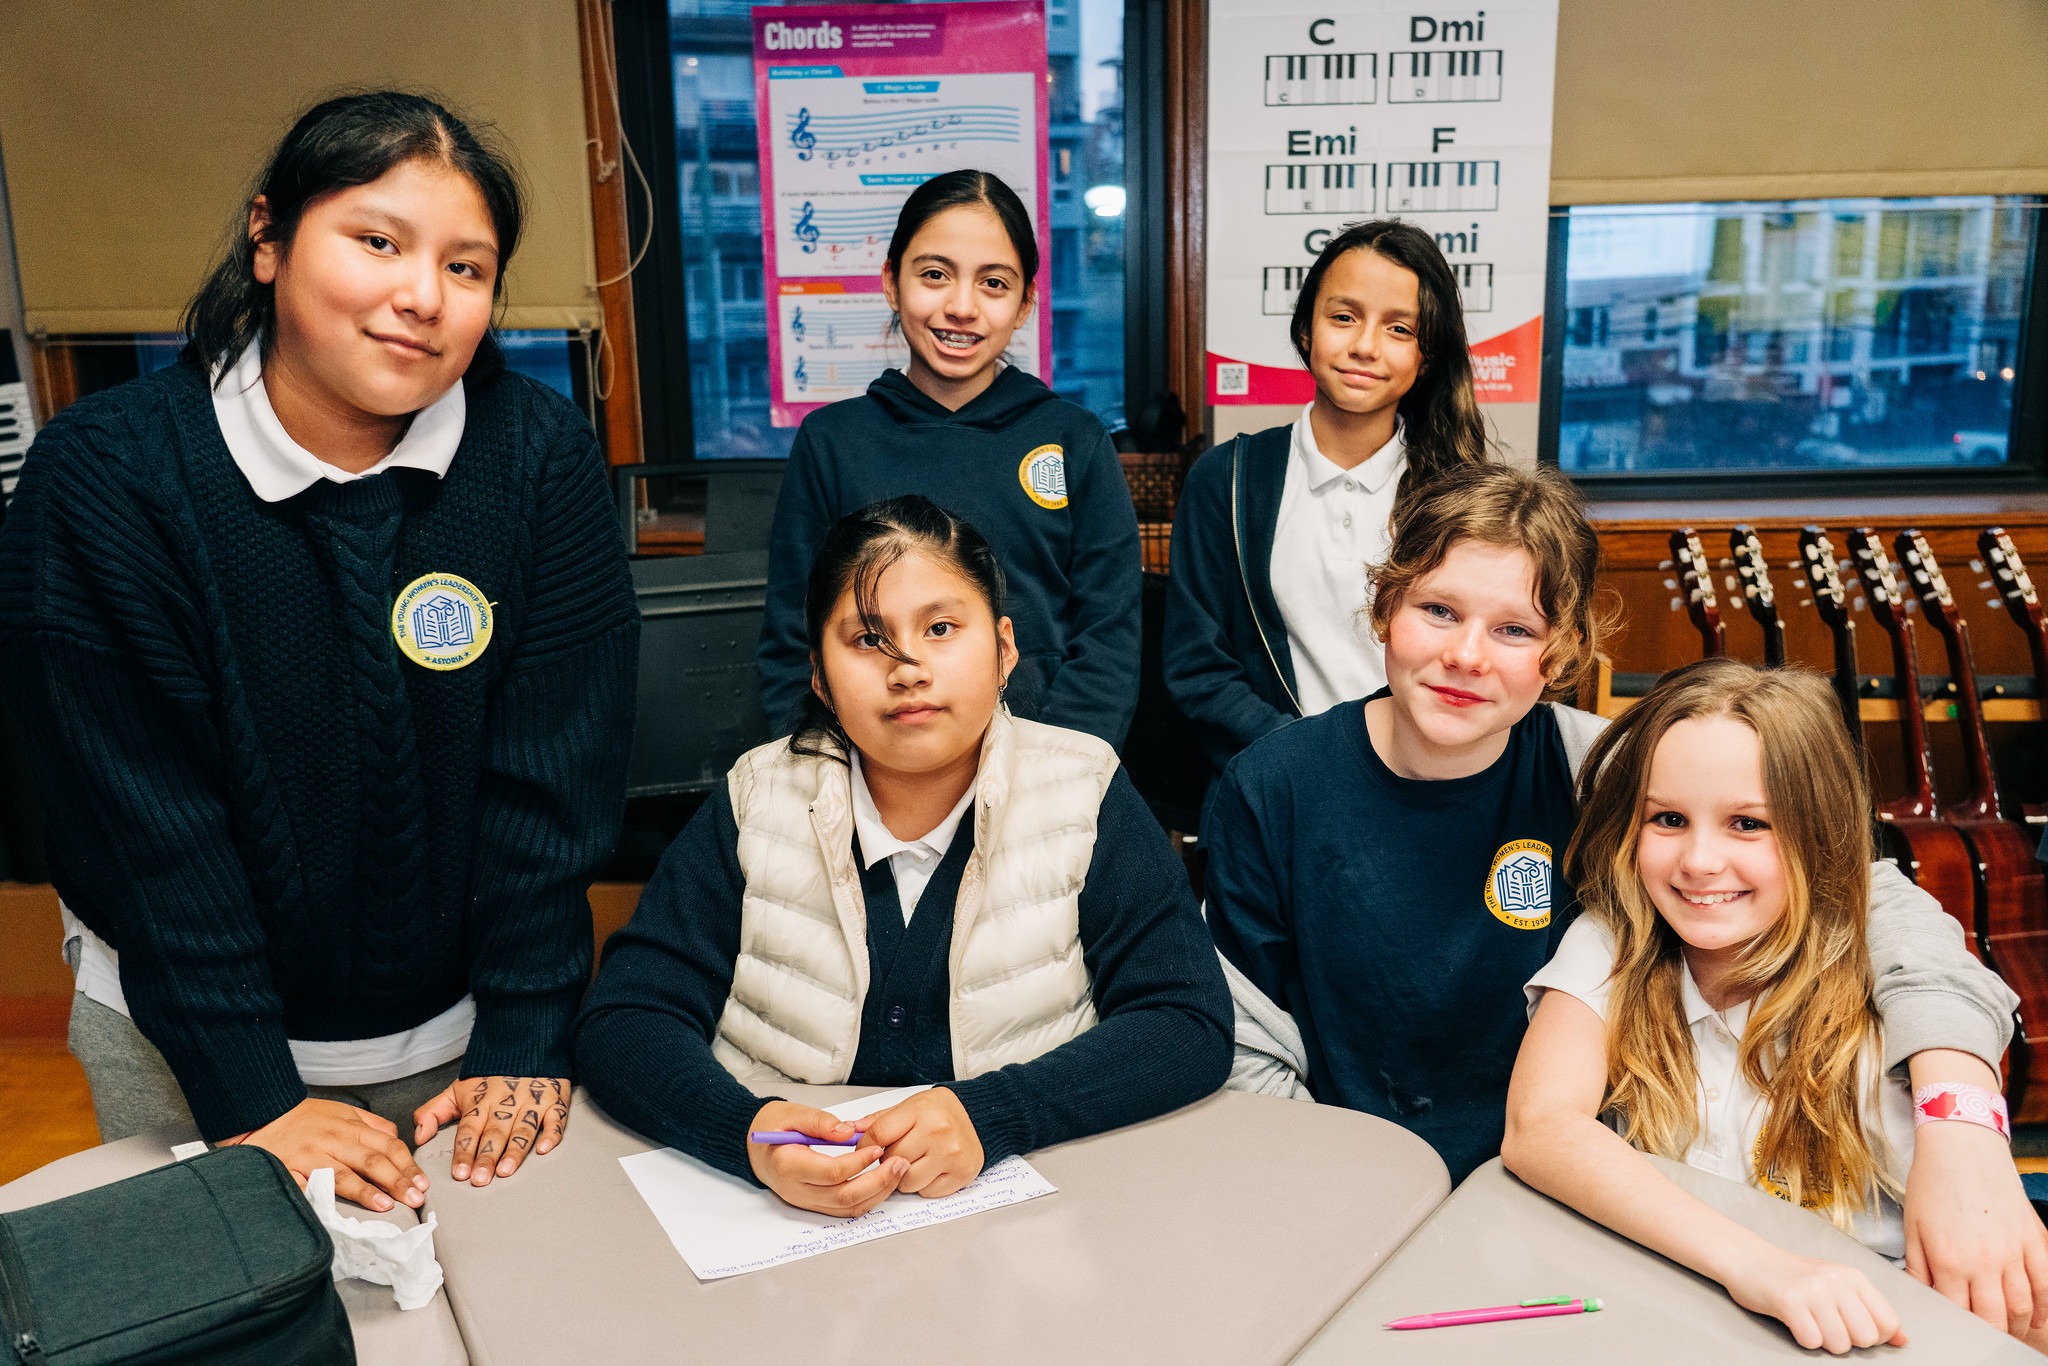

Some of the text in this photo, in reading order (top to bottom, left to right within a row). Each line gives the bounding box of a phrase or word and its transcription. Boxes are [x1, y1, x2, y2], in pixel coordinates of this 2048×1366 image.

[764, 21, 843, 50] Chords
[1309, 18, 1336, 46] C
[1410, 10, 1486, 44] Dmi
[1279, 93, 1289, 102] C
[1416, 88, 1425, 97] D
[1287, 126, 1357, 156] Emi
[1432, 127, 1456, 153] F
[1305, 201, 1313, 210] E
[1402, 199, 1410, 207] F
[1304, 229, 1331, 256] G
[1435, 223, 1479, 253] mi
[1468, 352, 1516, 367] usic
[397, 579, 488, 639] THE YOUNG WOMEN'S LEADERSHIP SCHOOL
[431, 655, 464, 665] ASTORIA
[1487, 895, 1497, 909] THE
[1493, 842, 1520, 866] WOMEN'S
[1513, 917, 1549, 927] EST 1996
